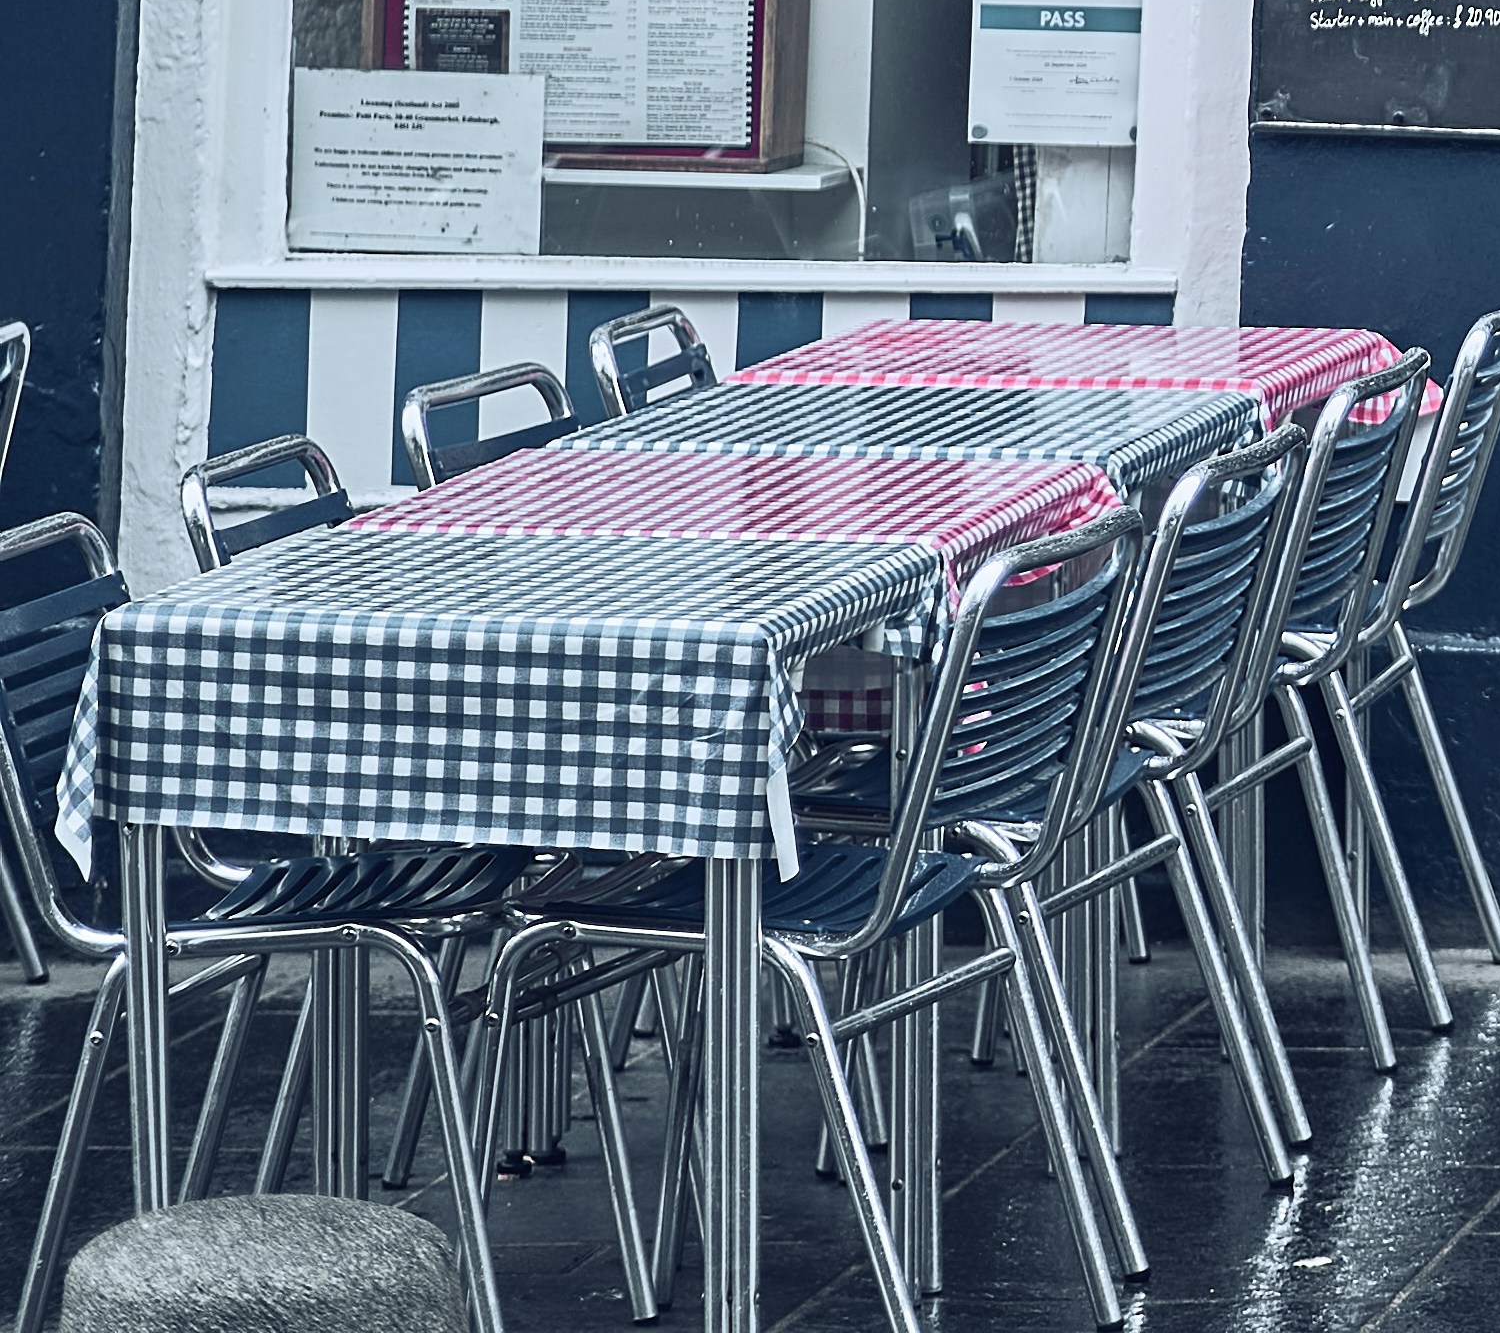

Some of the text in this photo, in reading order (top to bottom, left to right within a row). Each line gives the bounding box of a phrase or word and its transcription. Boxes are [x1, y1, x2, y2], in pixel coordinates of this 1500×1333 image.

[1040, 10, 1086, 29] PASS
[1368, 9, 1444, 37] main coffee
